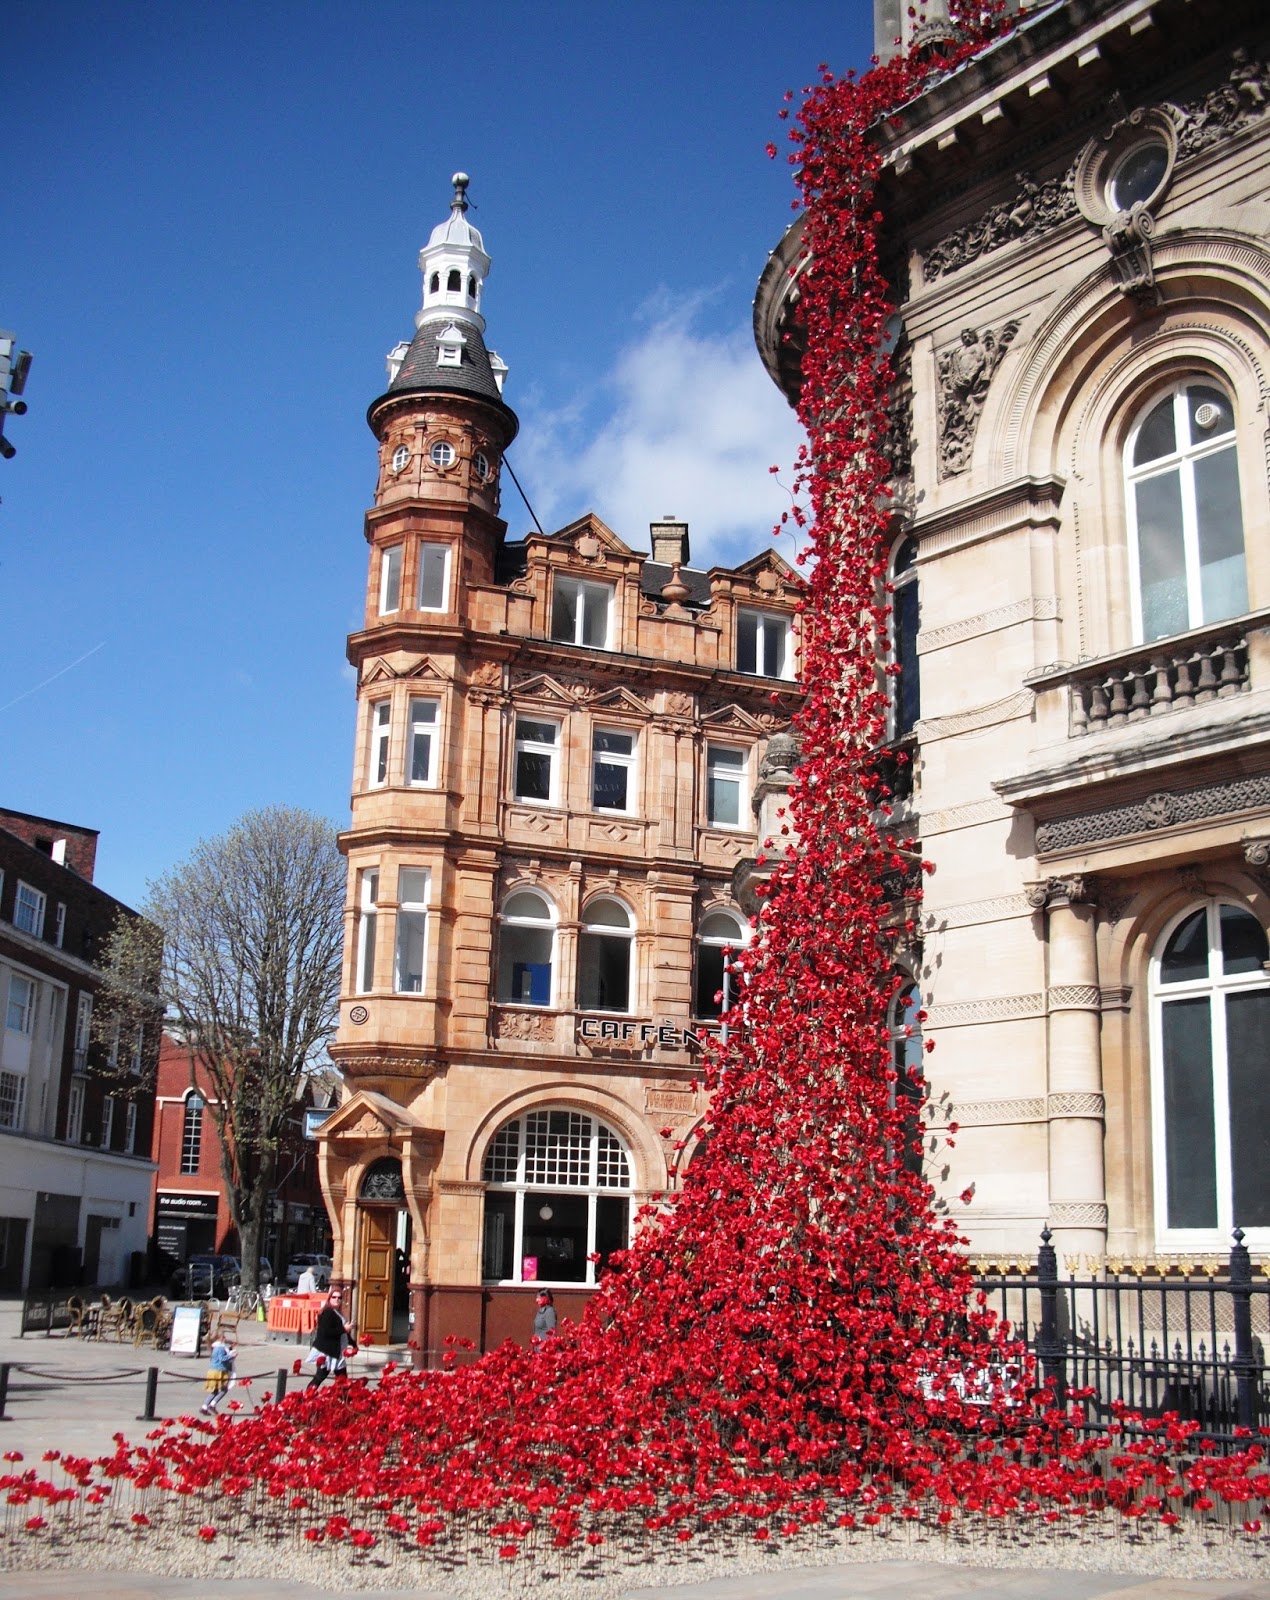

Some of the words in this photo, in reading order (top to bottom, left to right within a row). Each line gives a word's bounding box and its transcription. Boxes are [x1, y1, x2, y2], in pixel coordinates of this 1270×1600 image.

[581, 1018, 675, 1045] CAFFÈ
[160, 1197, 170, 1205] the
[170, 1197, 186, 1205] audio
